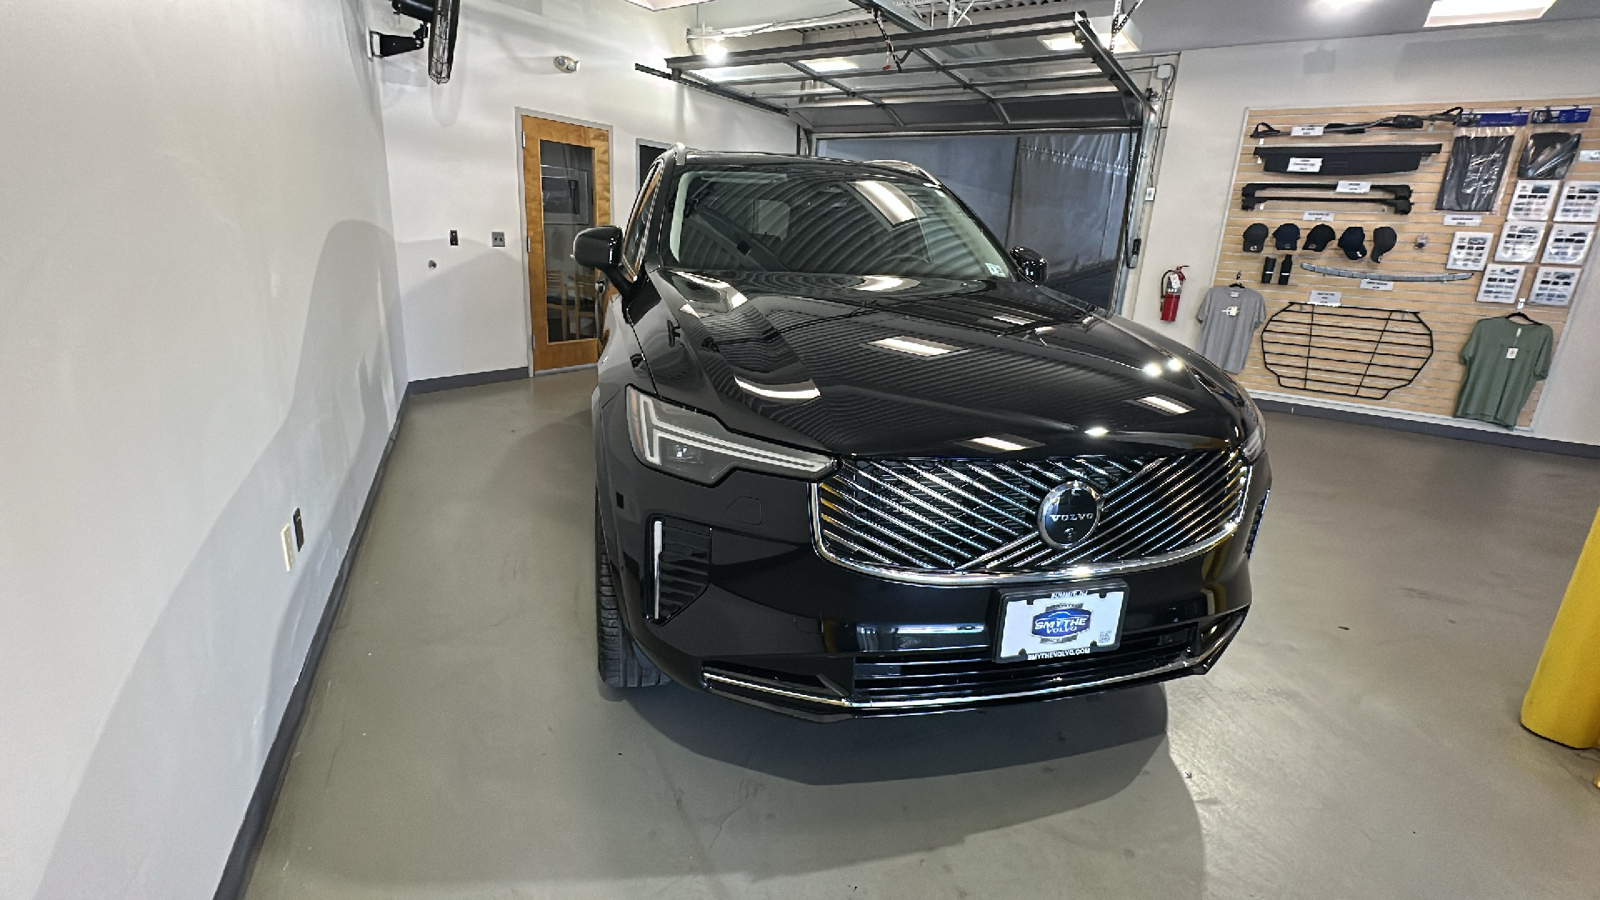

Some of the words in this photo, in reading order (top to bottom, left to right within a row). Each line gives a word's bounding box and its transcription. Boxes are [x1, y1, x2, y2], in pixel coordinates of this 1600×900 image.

[1050, 513, 1093, 522] VOLVO
[1035, 618, 1087, 630] SMYTHE
[1046, 625, 1078, 634] VOLVO
